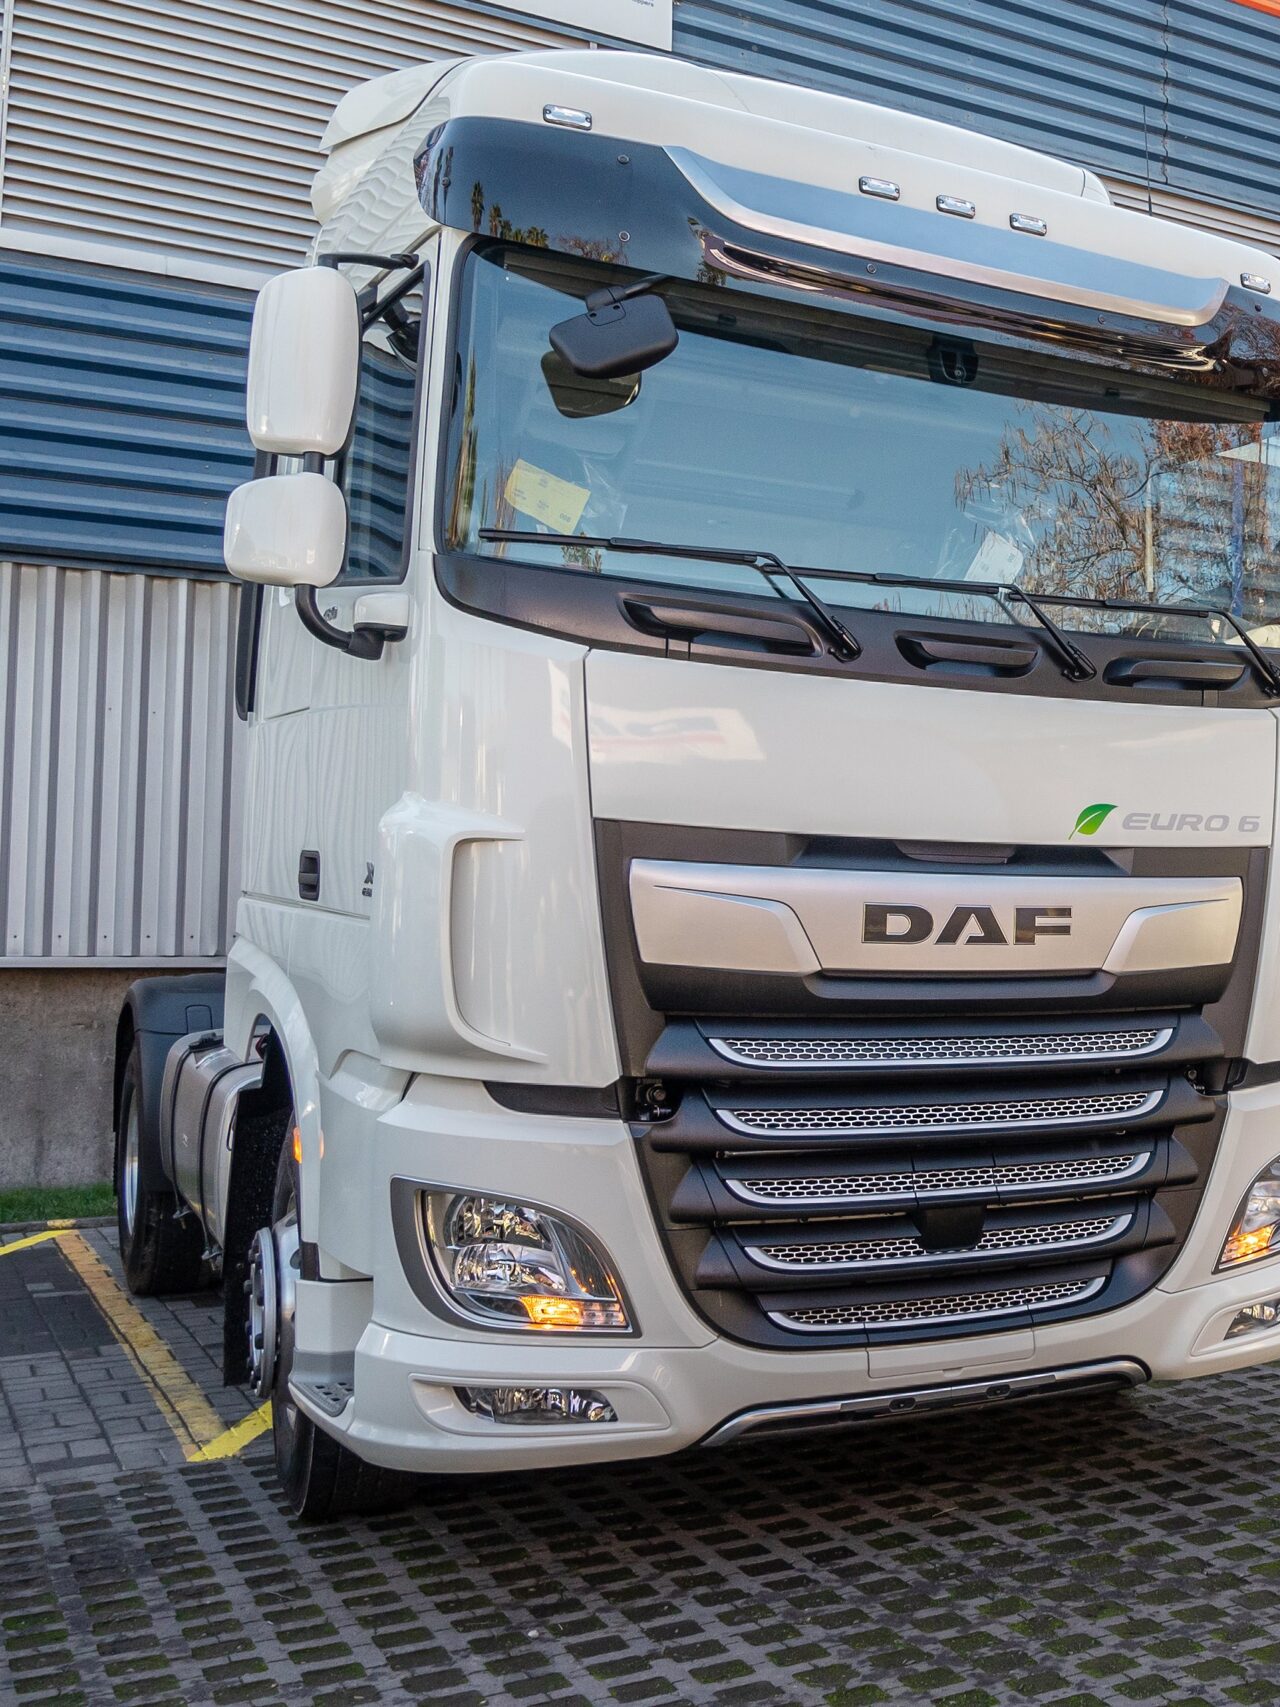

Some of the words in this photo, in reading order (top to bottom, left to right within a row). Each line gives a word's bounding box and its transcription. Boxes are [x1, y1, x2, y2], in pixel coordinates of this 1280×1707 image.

[1122, 812, 1230, 832] EURO
[1238, 815, 1261, 833] 6
[861, 902, 1073, 945] DAF
